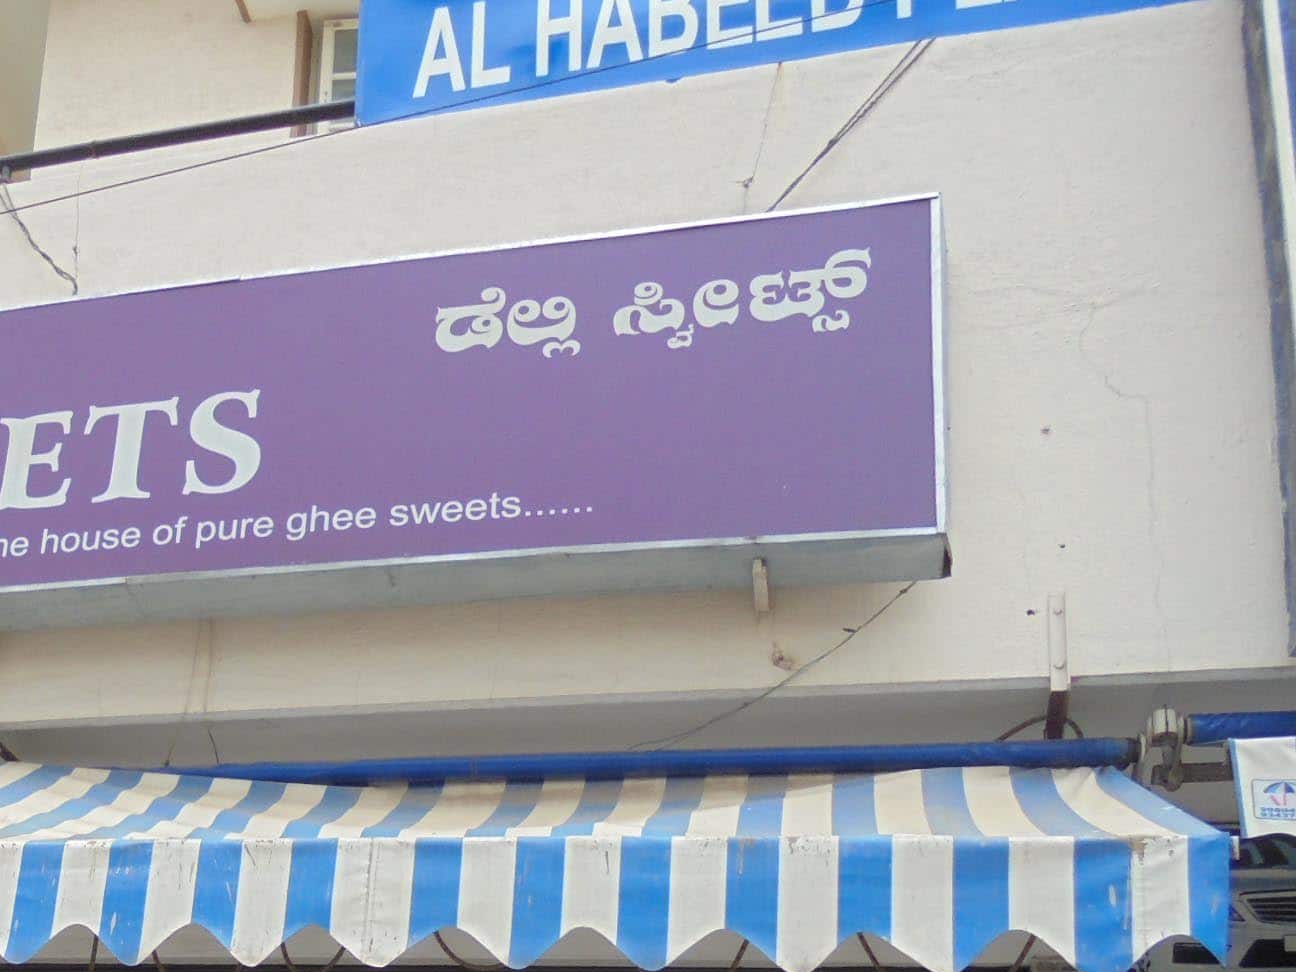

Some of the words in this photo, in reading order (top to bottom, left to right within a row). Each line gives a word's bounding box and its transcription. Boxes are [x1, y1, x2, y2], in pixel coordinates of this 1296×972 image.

[412, 1, 510, 98] AL
[435, 287, 581, 358] ಡೆಲ್ಲಿ
[40, 528, 142, 554] house
[152, 516, 187, 545] of
[195, 515, 275, 549] pure
[286, 505, 377, 541] ghee
